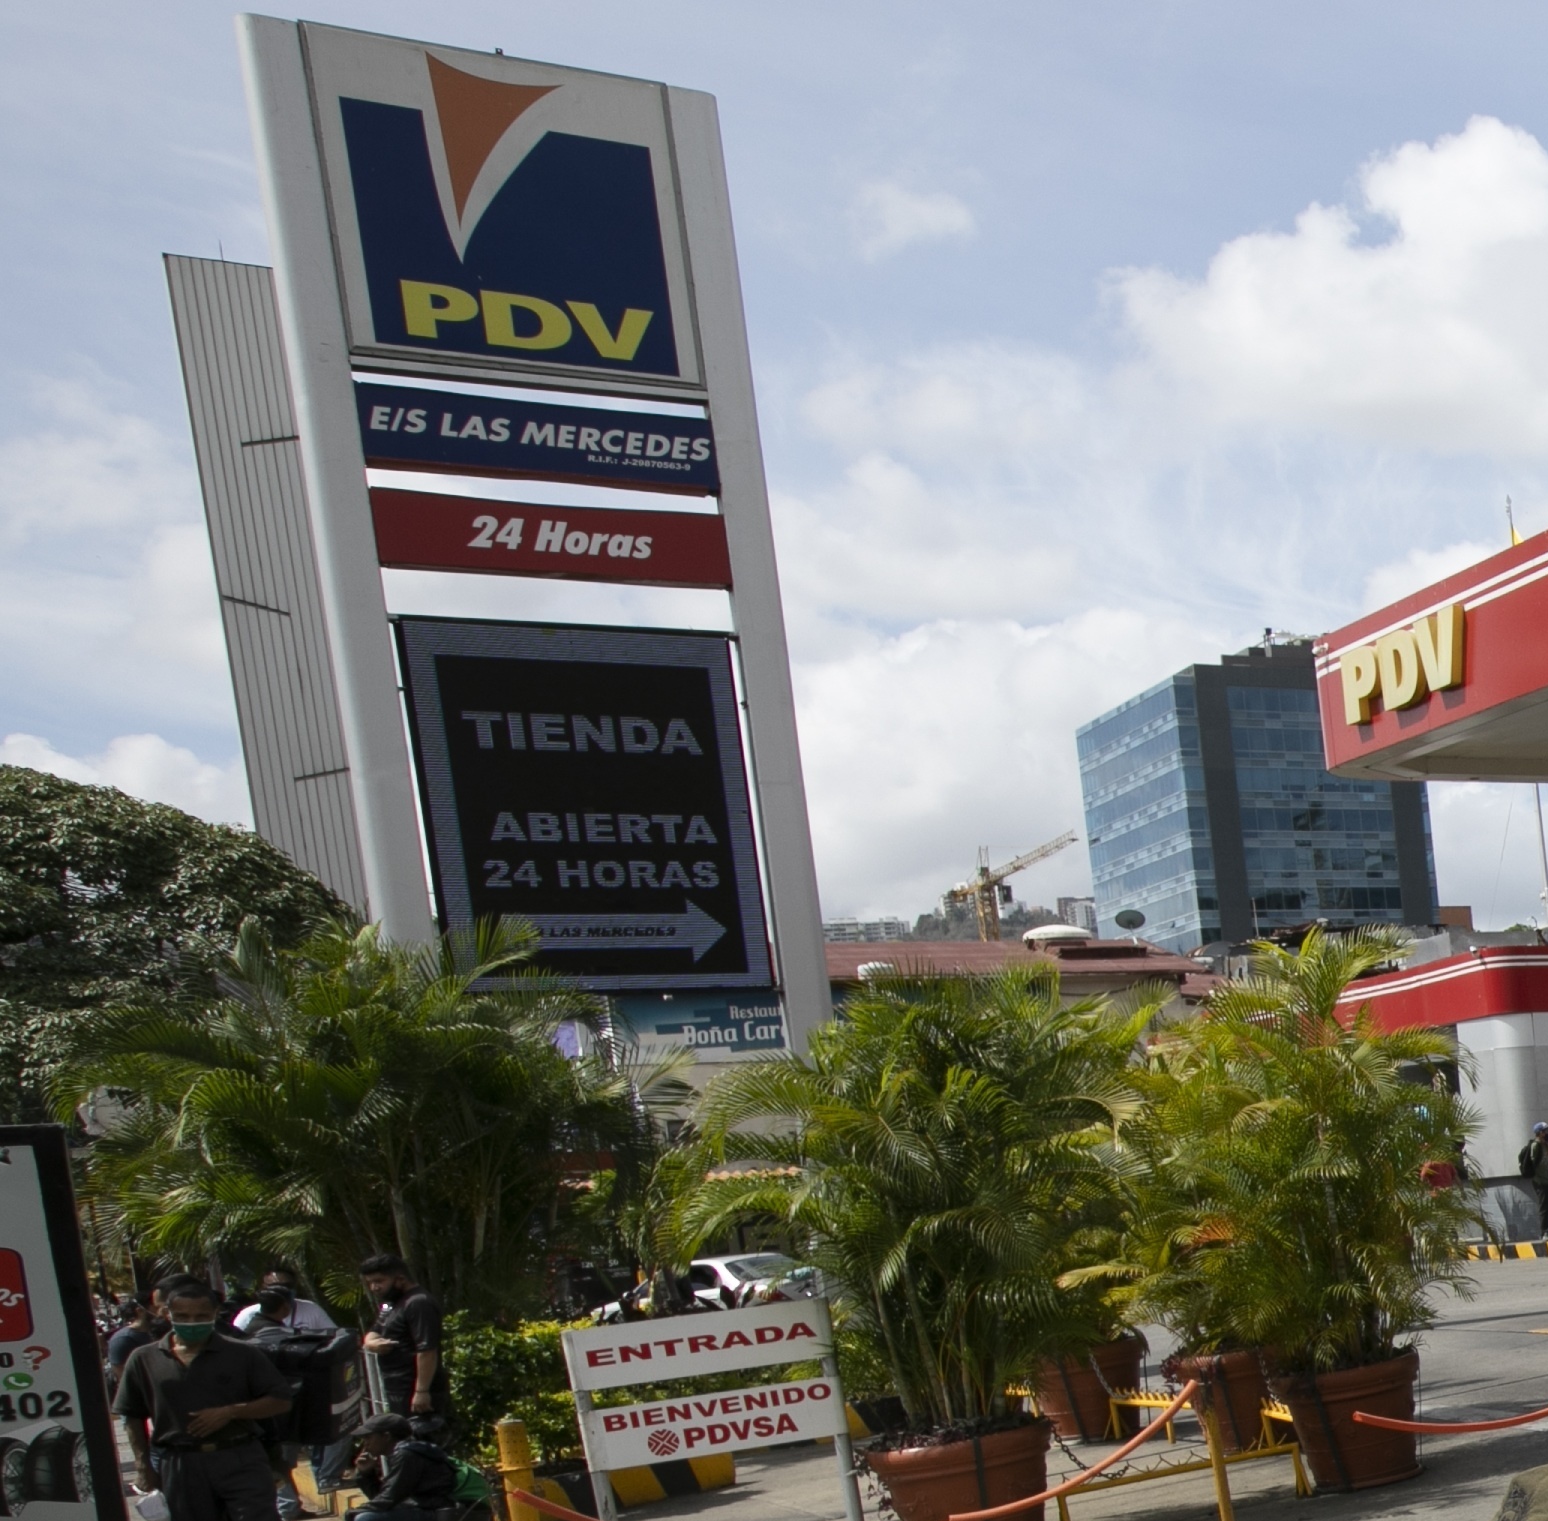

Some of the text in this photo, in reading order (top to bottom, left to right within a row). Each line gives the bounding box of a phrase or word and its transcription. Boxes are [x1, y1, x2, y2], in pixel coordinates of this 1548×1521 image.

[400, 278, 654, 361] PDV
[370, 405, 711, 461] E/S LAS MERCEDES
[467, 515, 652, 559] 24 Horas
[1341, 604, 1465, 725] PDV
[461, 711, 703, 755] TIENDA
[491, 812, 718, 844] ABIERTA
[483, 859, 720, 888] 24 HORAS
[587, 927, 677, 938] MERCEDES
[682, 1025, 738, 1045] Doña
[586, 1321, 818, 1368] ENTRADA
[603, 1382, 832, 1433] BIENVENIDO
[684, 1413, 799, 1450] PDVSA
